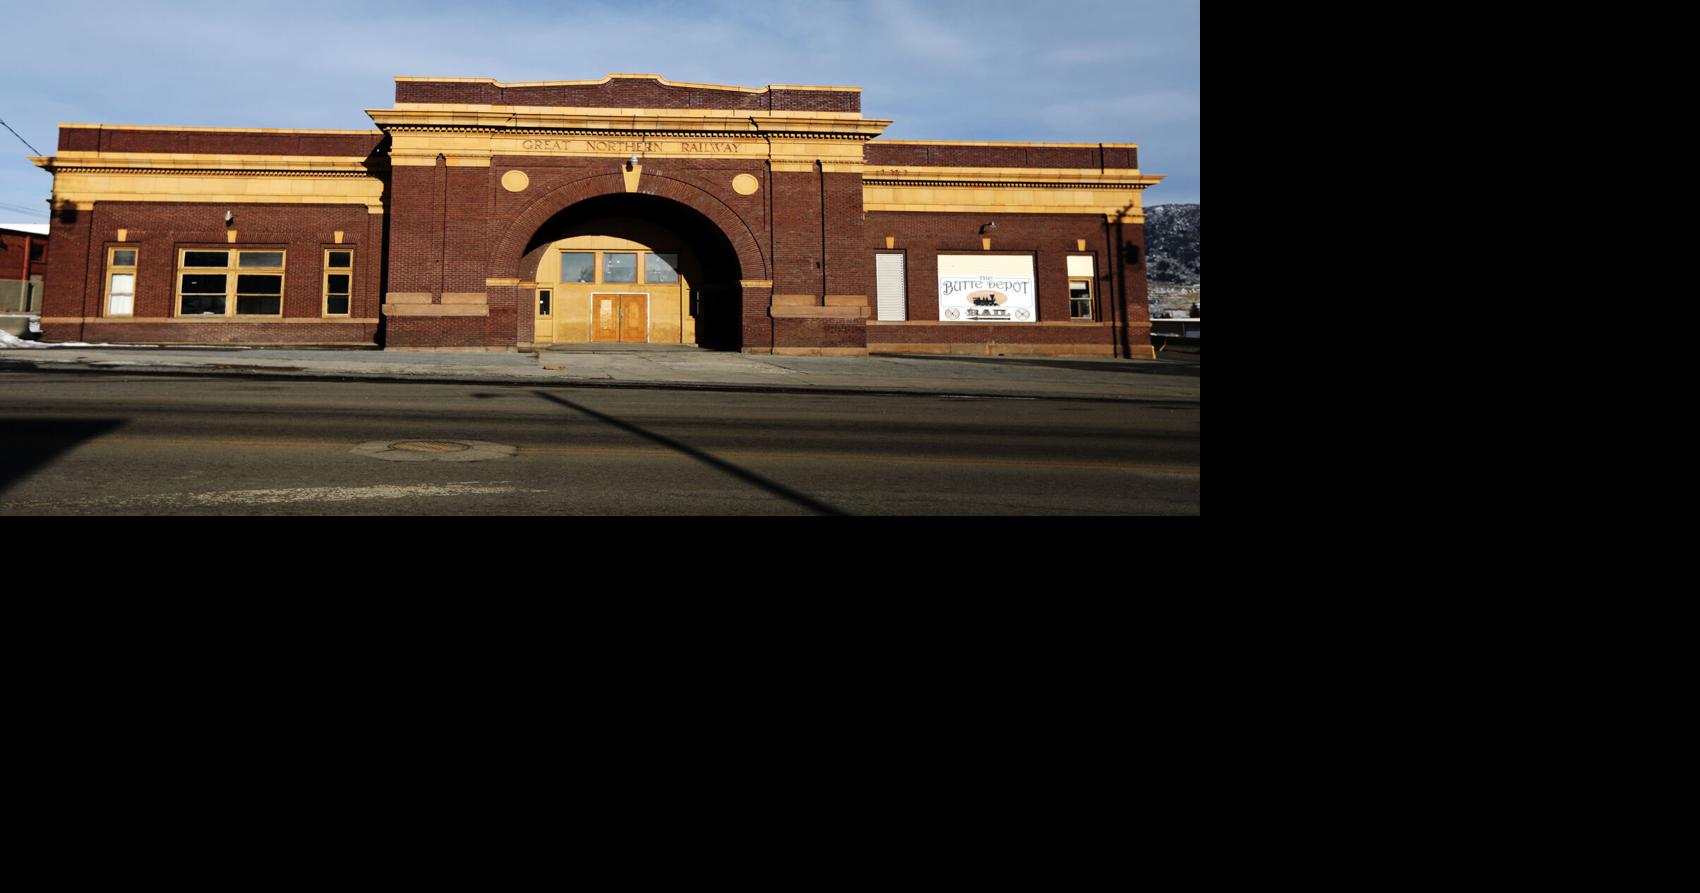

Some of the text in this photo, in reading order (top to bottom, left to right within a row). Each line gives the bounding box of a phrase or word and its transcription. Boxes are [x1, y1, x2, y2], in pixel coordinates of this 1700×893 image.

[522, 140, 741, 153] GREAT NORTHERN RAILWAY
